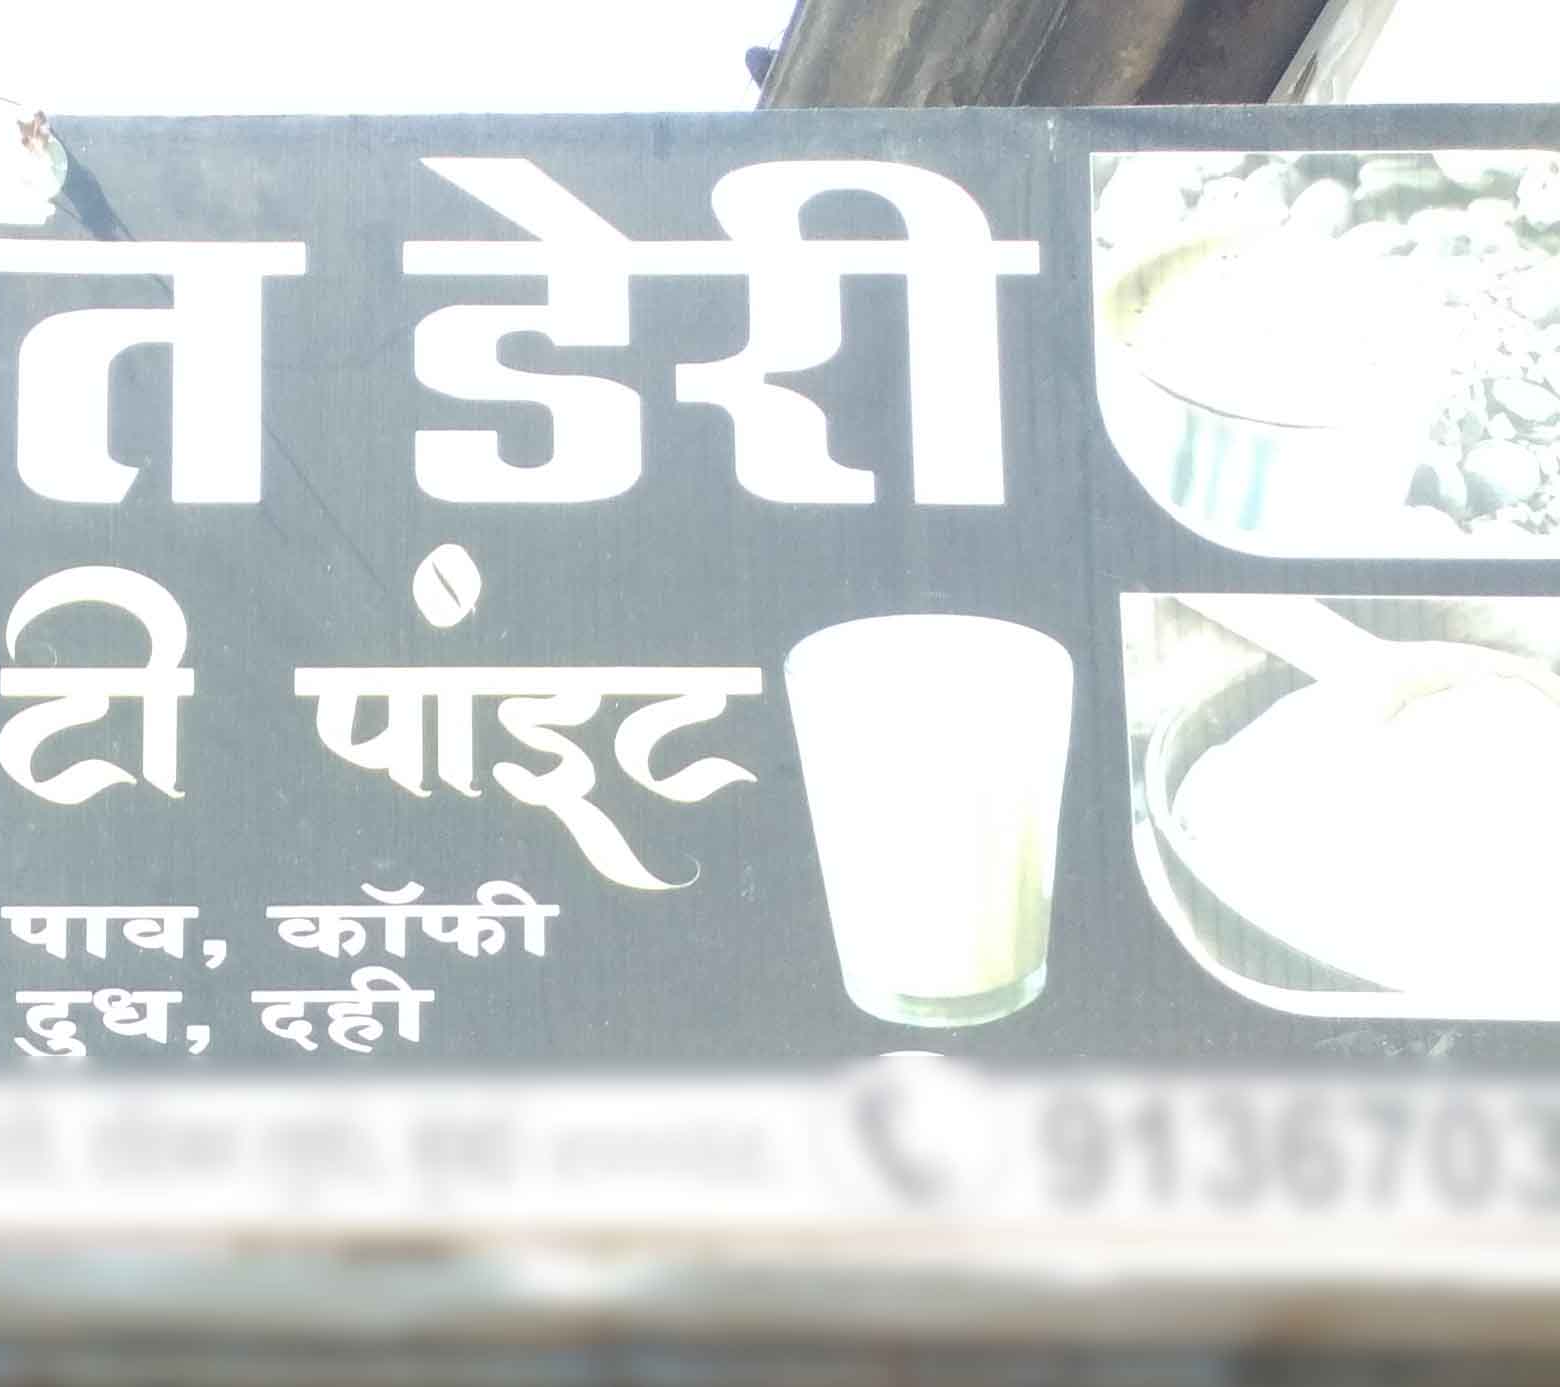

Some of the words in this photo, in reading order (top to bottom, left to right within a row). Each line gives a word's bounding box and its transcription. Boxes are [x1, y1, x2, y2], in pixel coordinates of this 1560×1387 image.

[402, 157, 1041, 506] डेरी
[0, 906, 227, 969] पाव,
[265, 880, 561, 960] कॉफी
[12, 986, 210, 1058] दुध,
[250, 966, 435, 1053] दही
